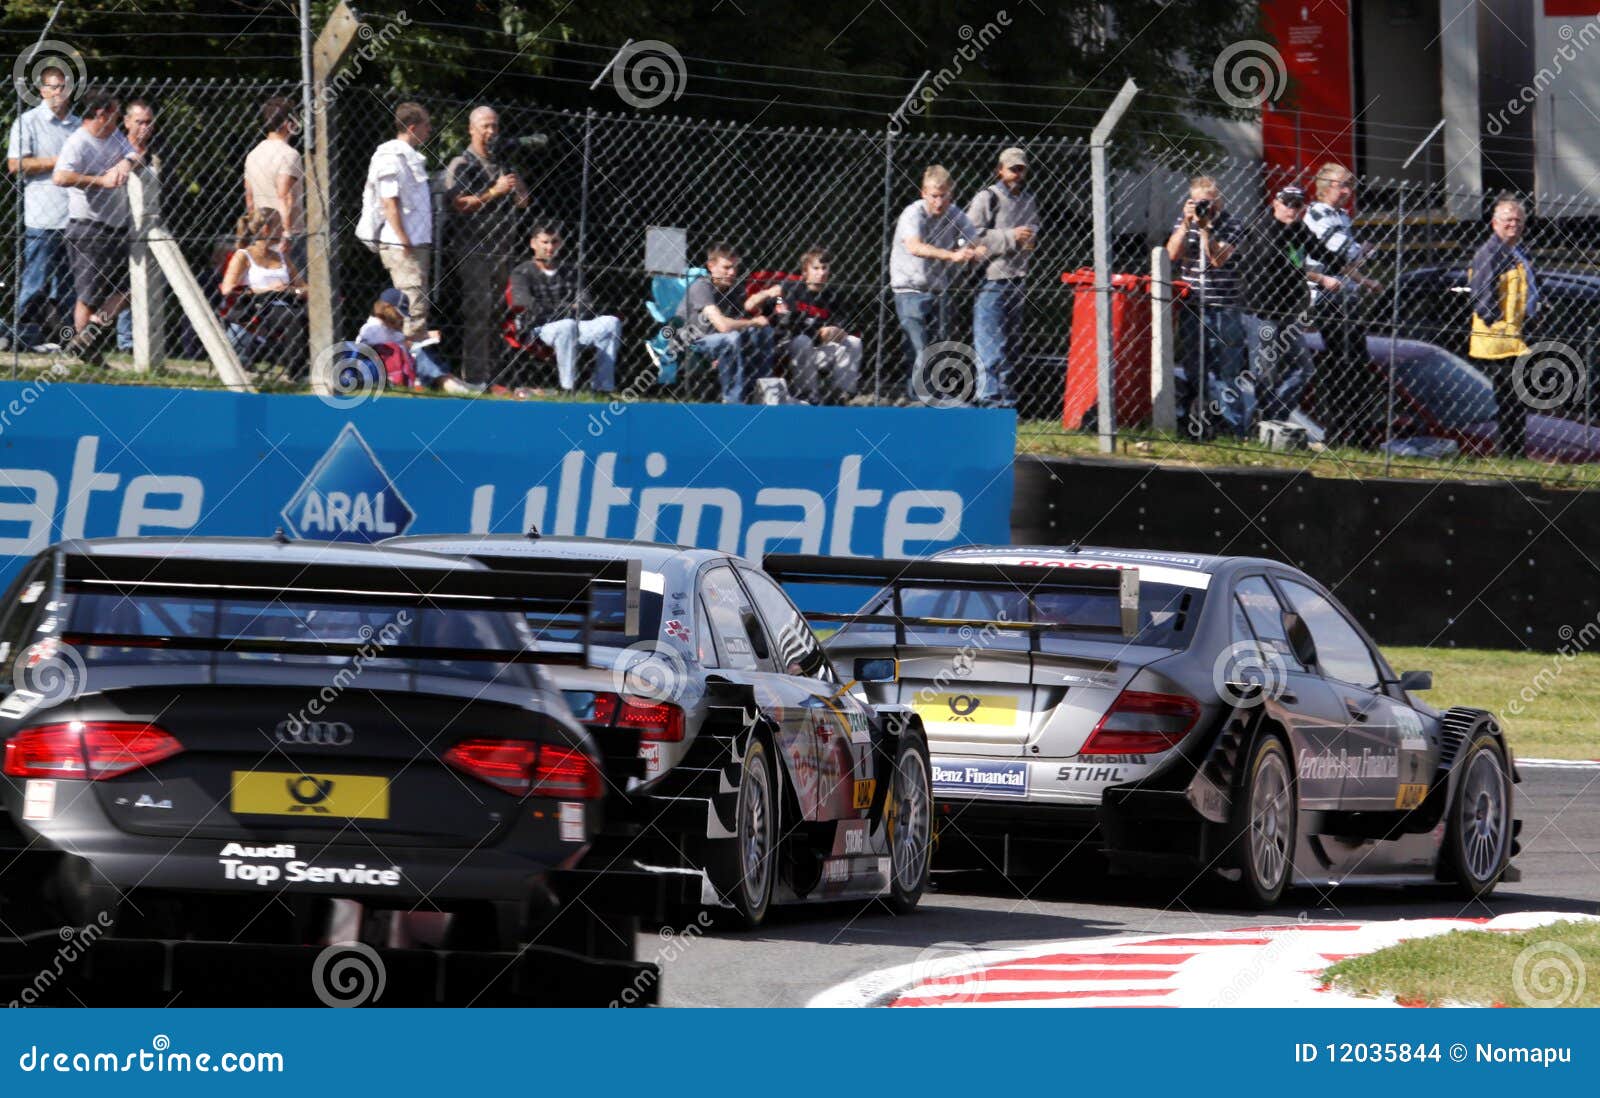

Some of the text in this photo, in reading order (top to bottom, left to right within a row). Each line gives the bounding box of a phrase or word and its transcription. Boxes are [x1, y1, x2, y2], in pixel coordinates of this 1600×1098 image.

[300, 492, 397, 534] ARAL
[470, 449, 964, 560] ultimate
[1100, 551, 1197, 565] Financial
[1077, 755, 1128, 765] Mobil
[931, 766, 1025, 786] Benz Financial
[1056, 766, 1124, 782] STIHL
[218, 842, 296, 859] Audi
[218, 858, 401, 886] Top Service
